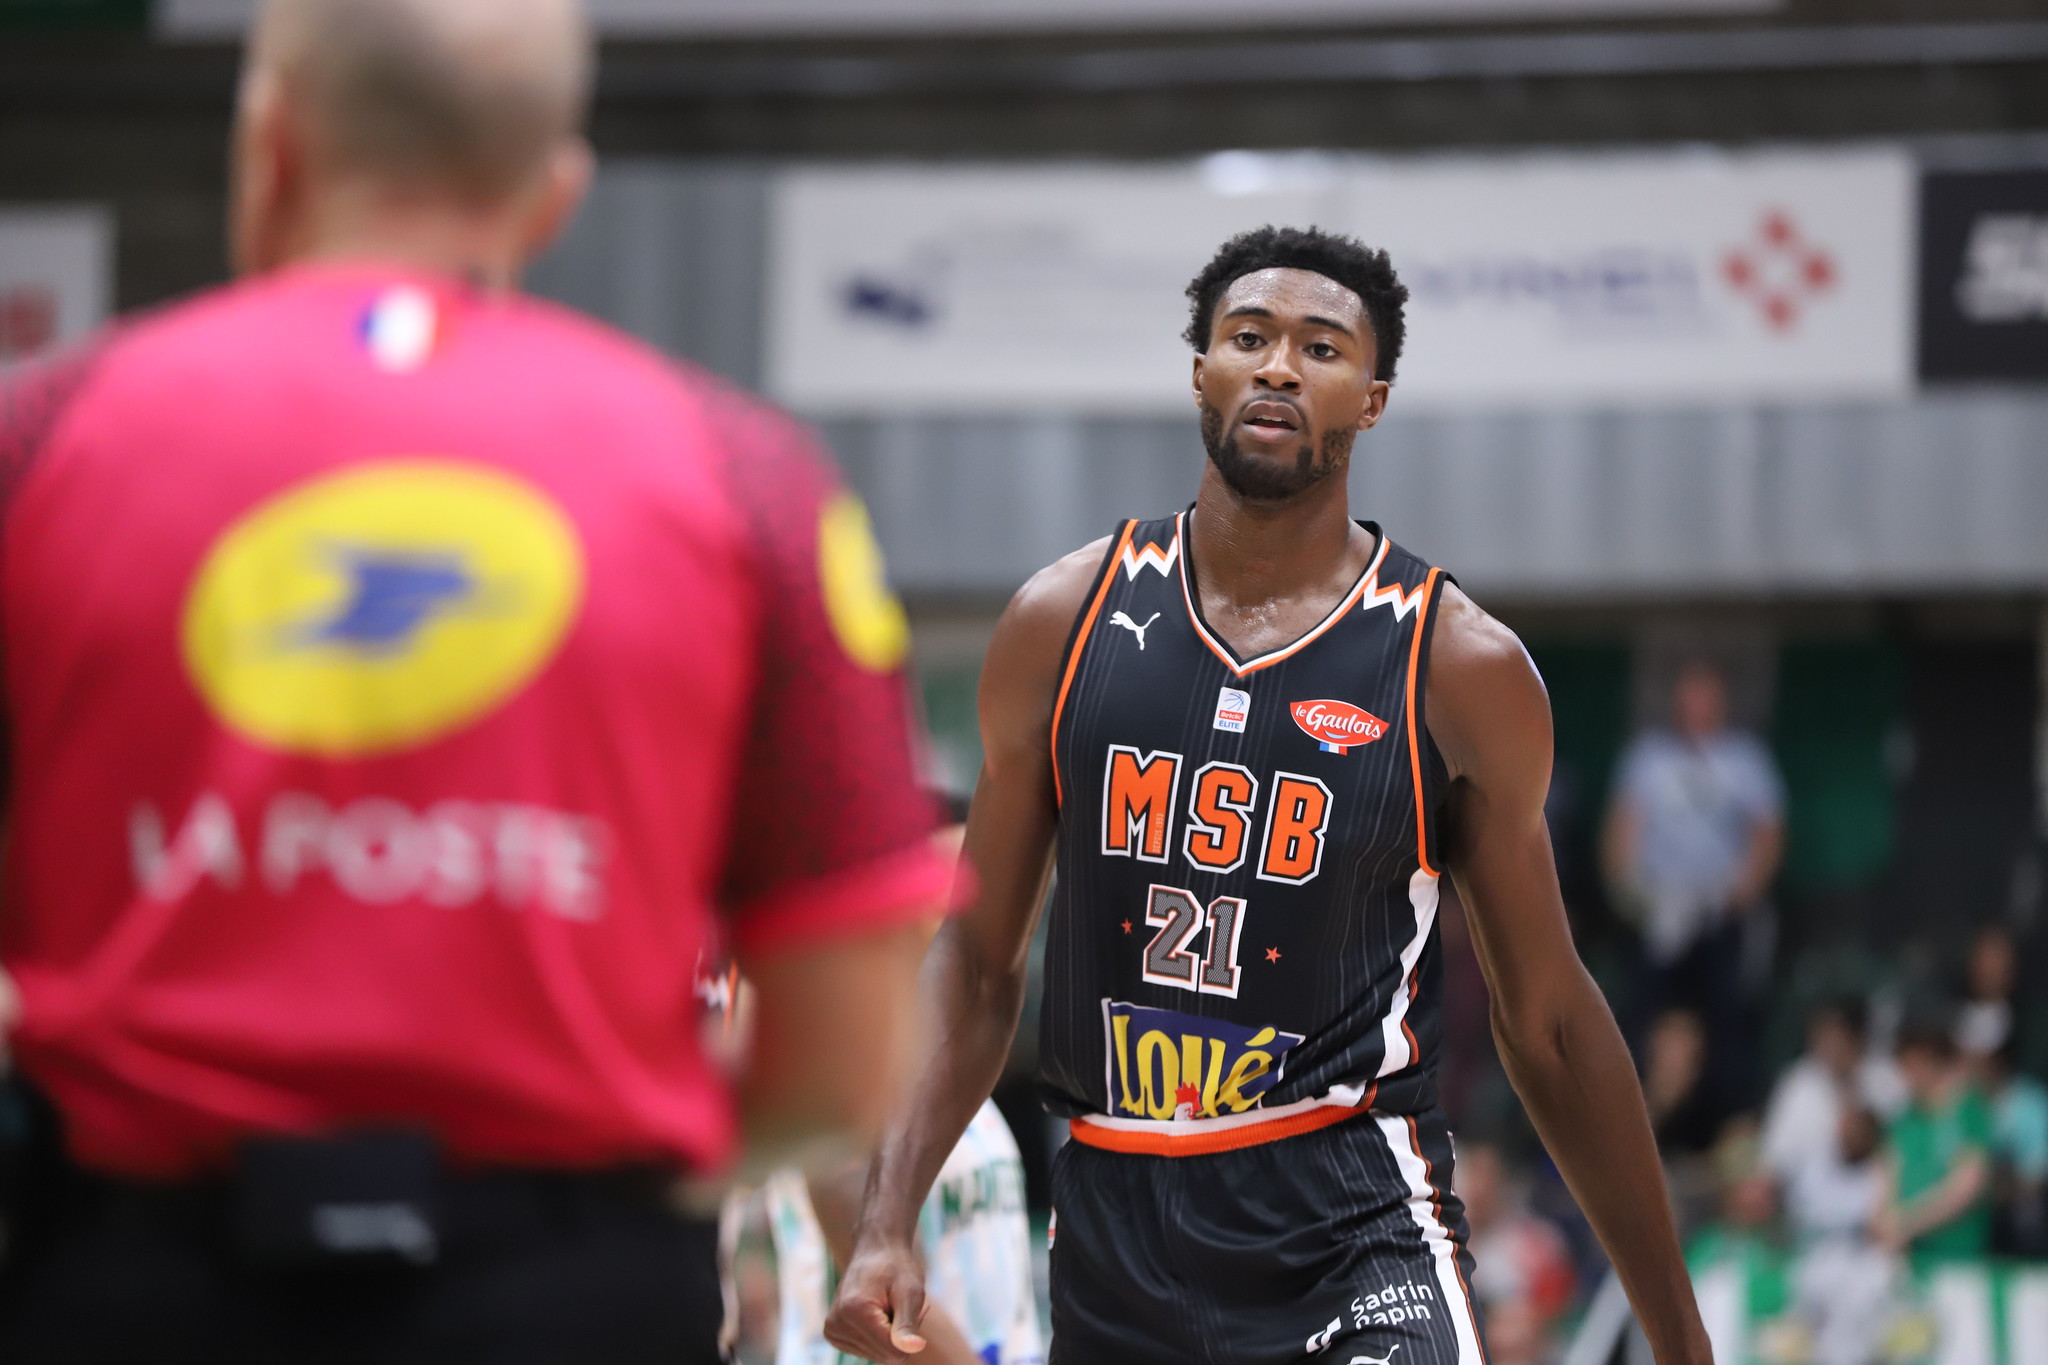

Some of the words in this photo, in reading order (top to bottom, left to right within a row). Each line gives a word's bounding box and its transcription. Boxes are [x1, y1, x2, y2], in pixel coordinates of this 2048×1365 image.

[1295, 704, 1306, 717] le
[1306, 704, 1381, 738] Gaulois
[127, 795, 244, 900] LA
[262, 793, 608, 920] POSTE
[1102, 744, 1334, 885] MSB
[1143, 884, 1247, 999] 21
